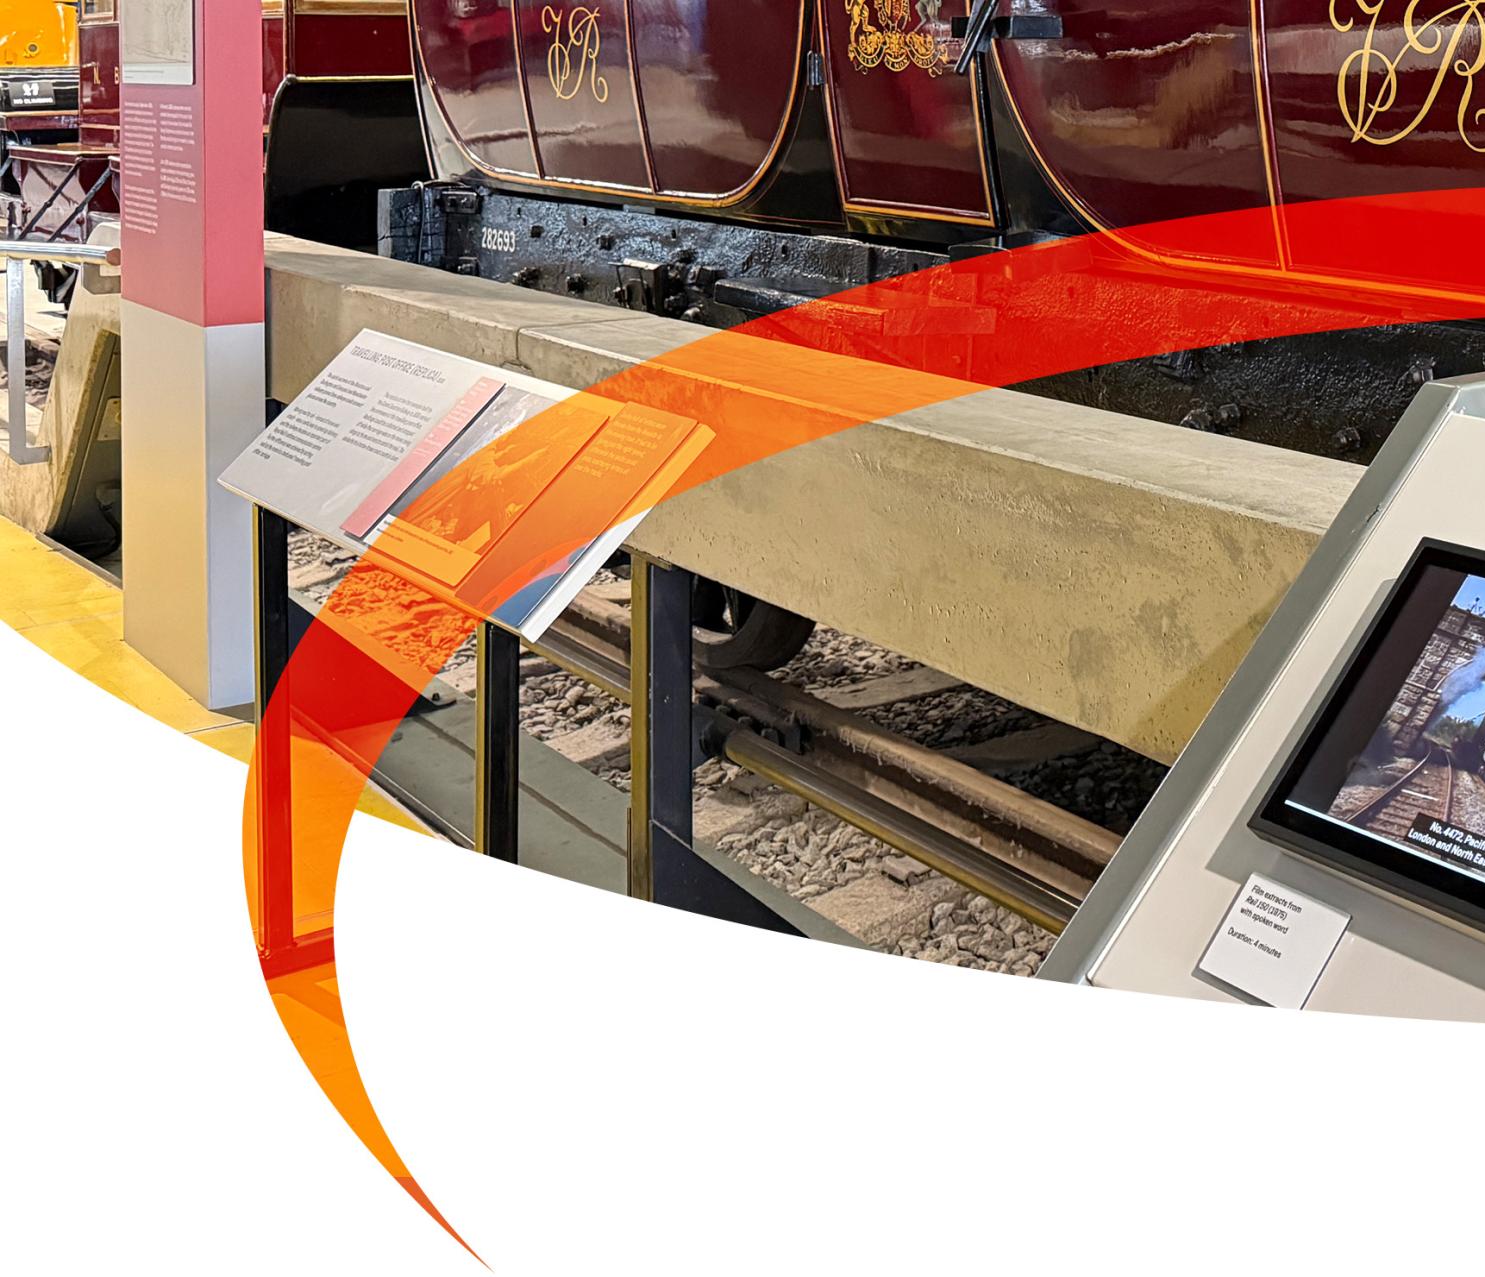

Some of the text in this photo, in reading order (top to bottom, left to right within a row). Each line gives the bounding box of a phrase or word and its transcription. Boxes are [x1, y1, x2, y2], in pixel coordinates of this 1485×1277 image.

[481, 226, 516, 253] 282693
[1429, 821, 1442, 835] No.
[1408, 828, 1436, 846] London
[1436, 840, 1452, 853] and
[1451, 844, 1474, 861] North
[1245, 895, 1288, 921] Rail 150 (1975)
[1251, 884, 1302, 913] Film extracts from
[1240, 907, 1289, 934] with spoken word
[1227, 926, 1253, 945] Duration:
[1258, 943, 1282, 959] minutes
